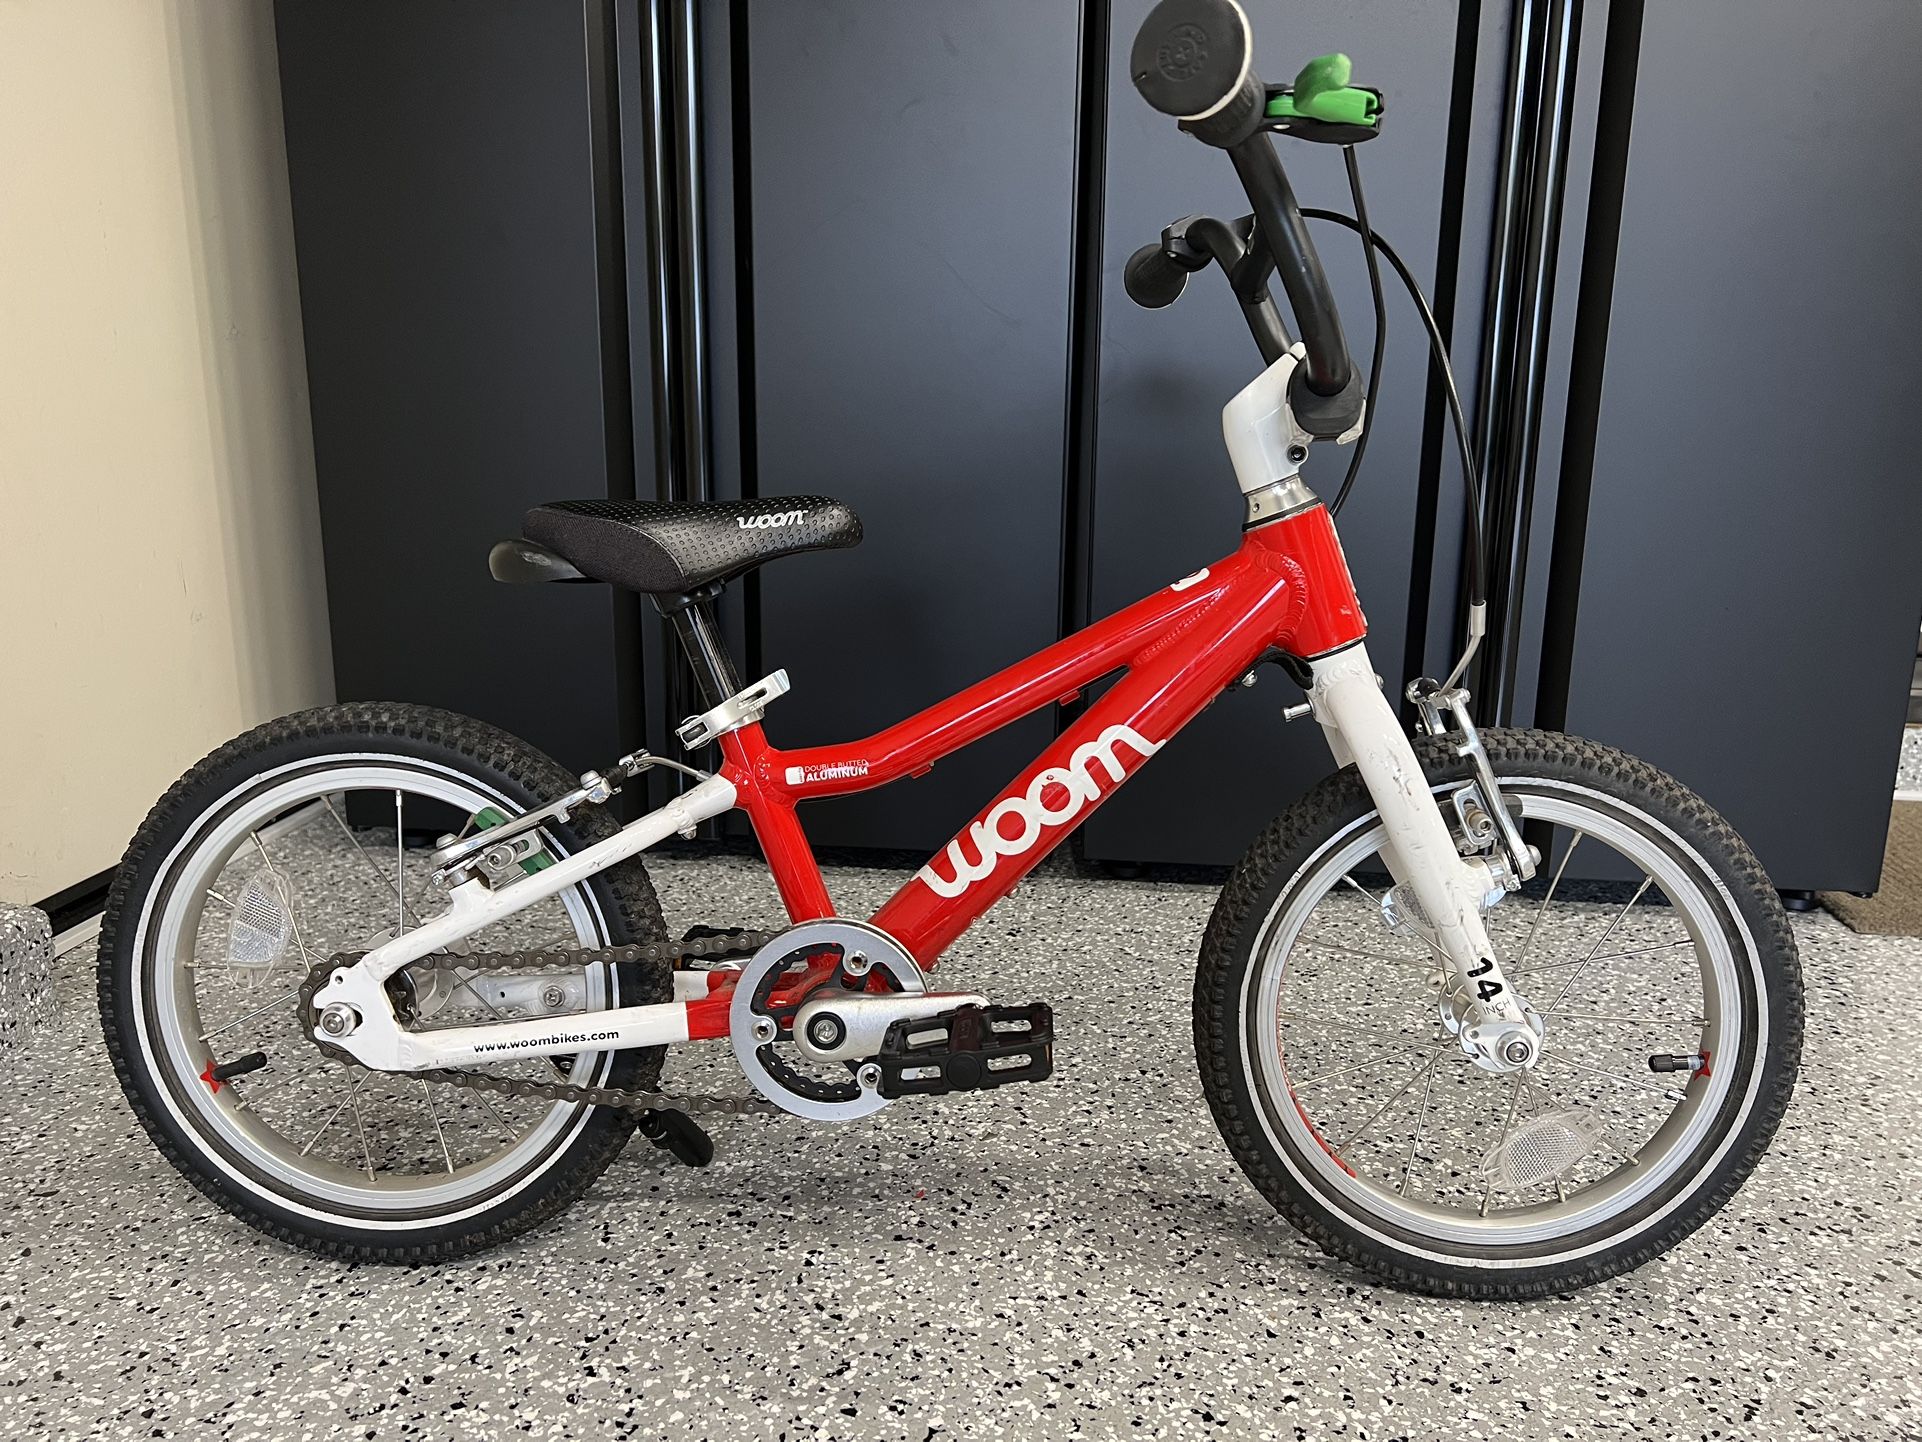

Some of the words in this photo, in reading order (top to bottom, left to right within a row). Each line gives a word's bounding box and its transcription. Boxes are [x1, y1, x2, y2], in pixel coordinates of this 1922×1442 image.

[736, 509, 806, 529] woom
[805, 763, 836, 772] DOUBLE
[806, 766, 868, 781] ALUMINUM
[911, 724, 1167, 898] woom
[1467, 957, 1503, 1002] 14
[1483, 999, 1511, 1015] INCH
[474, 1031, 619, 1052] www.woombikes.com
